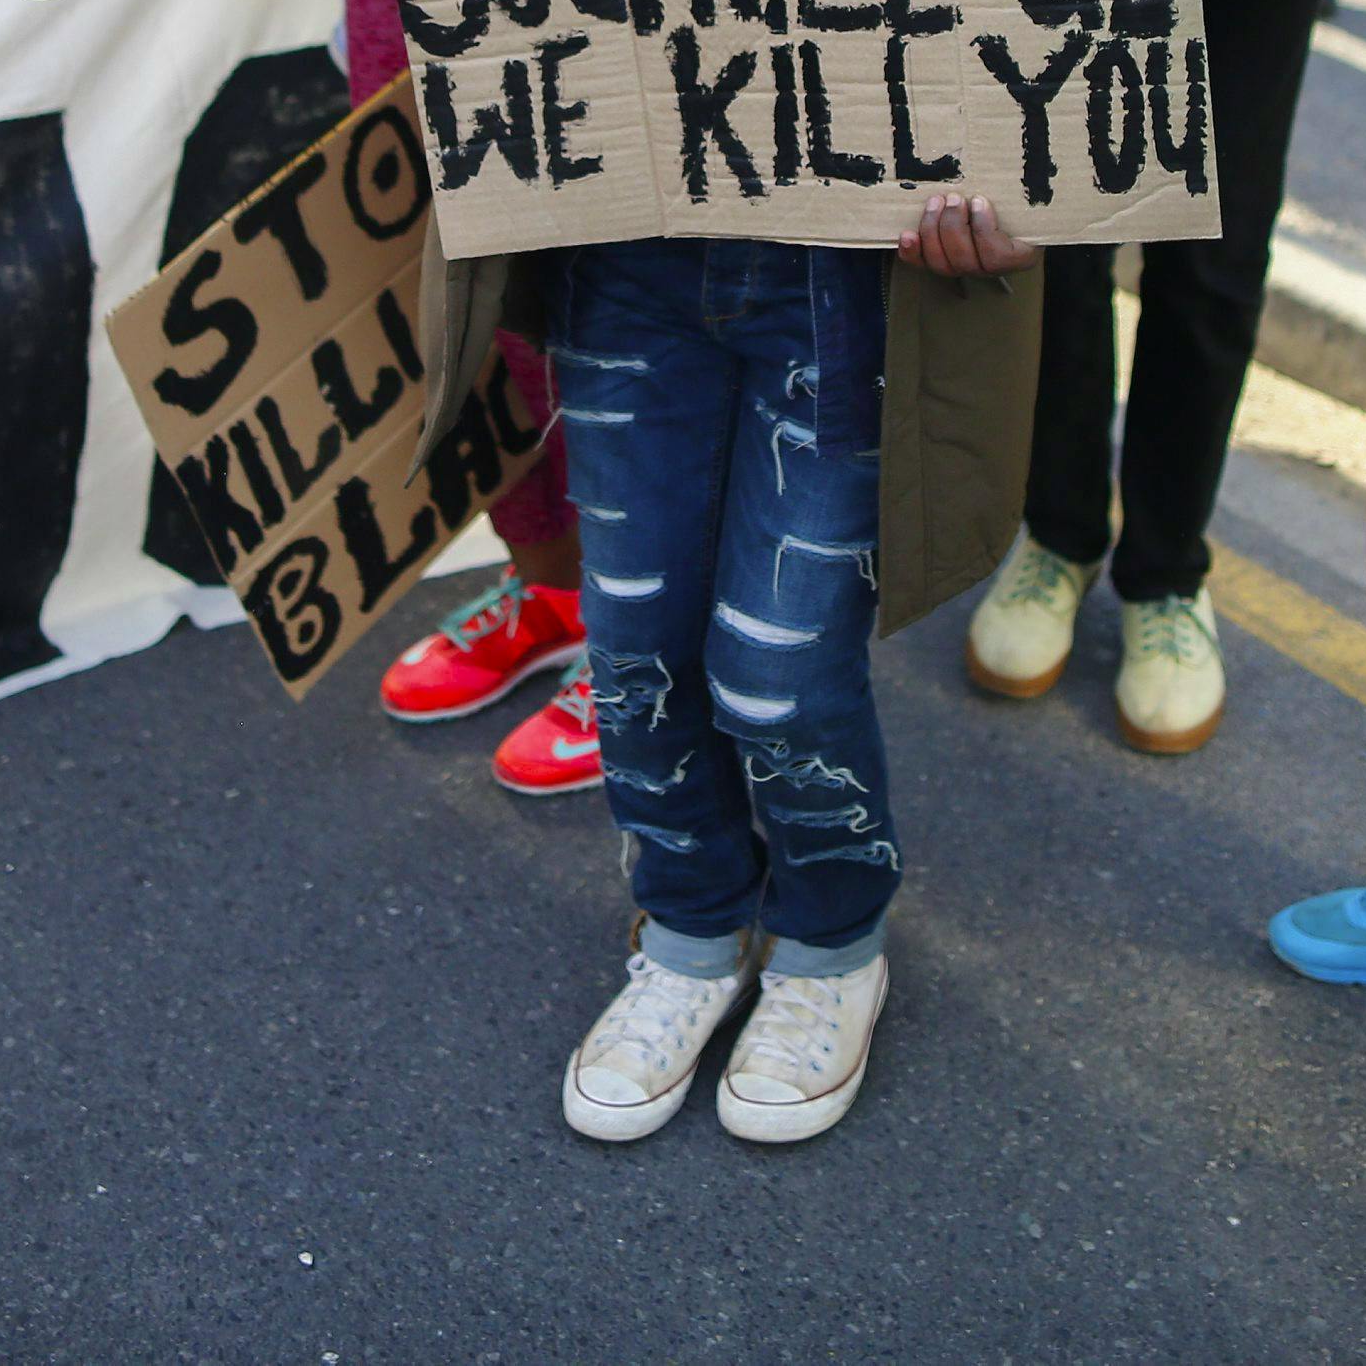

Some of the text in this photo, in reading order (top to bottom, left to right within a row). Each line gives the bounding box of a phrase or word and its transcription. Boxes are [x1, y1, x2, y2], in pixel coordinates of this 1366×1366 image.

[426, 24, 1209, 207] WE KILL YOU
